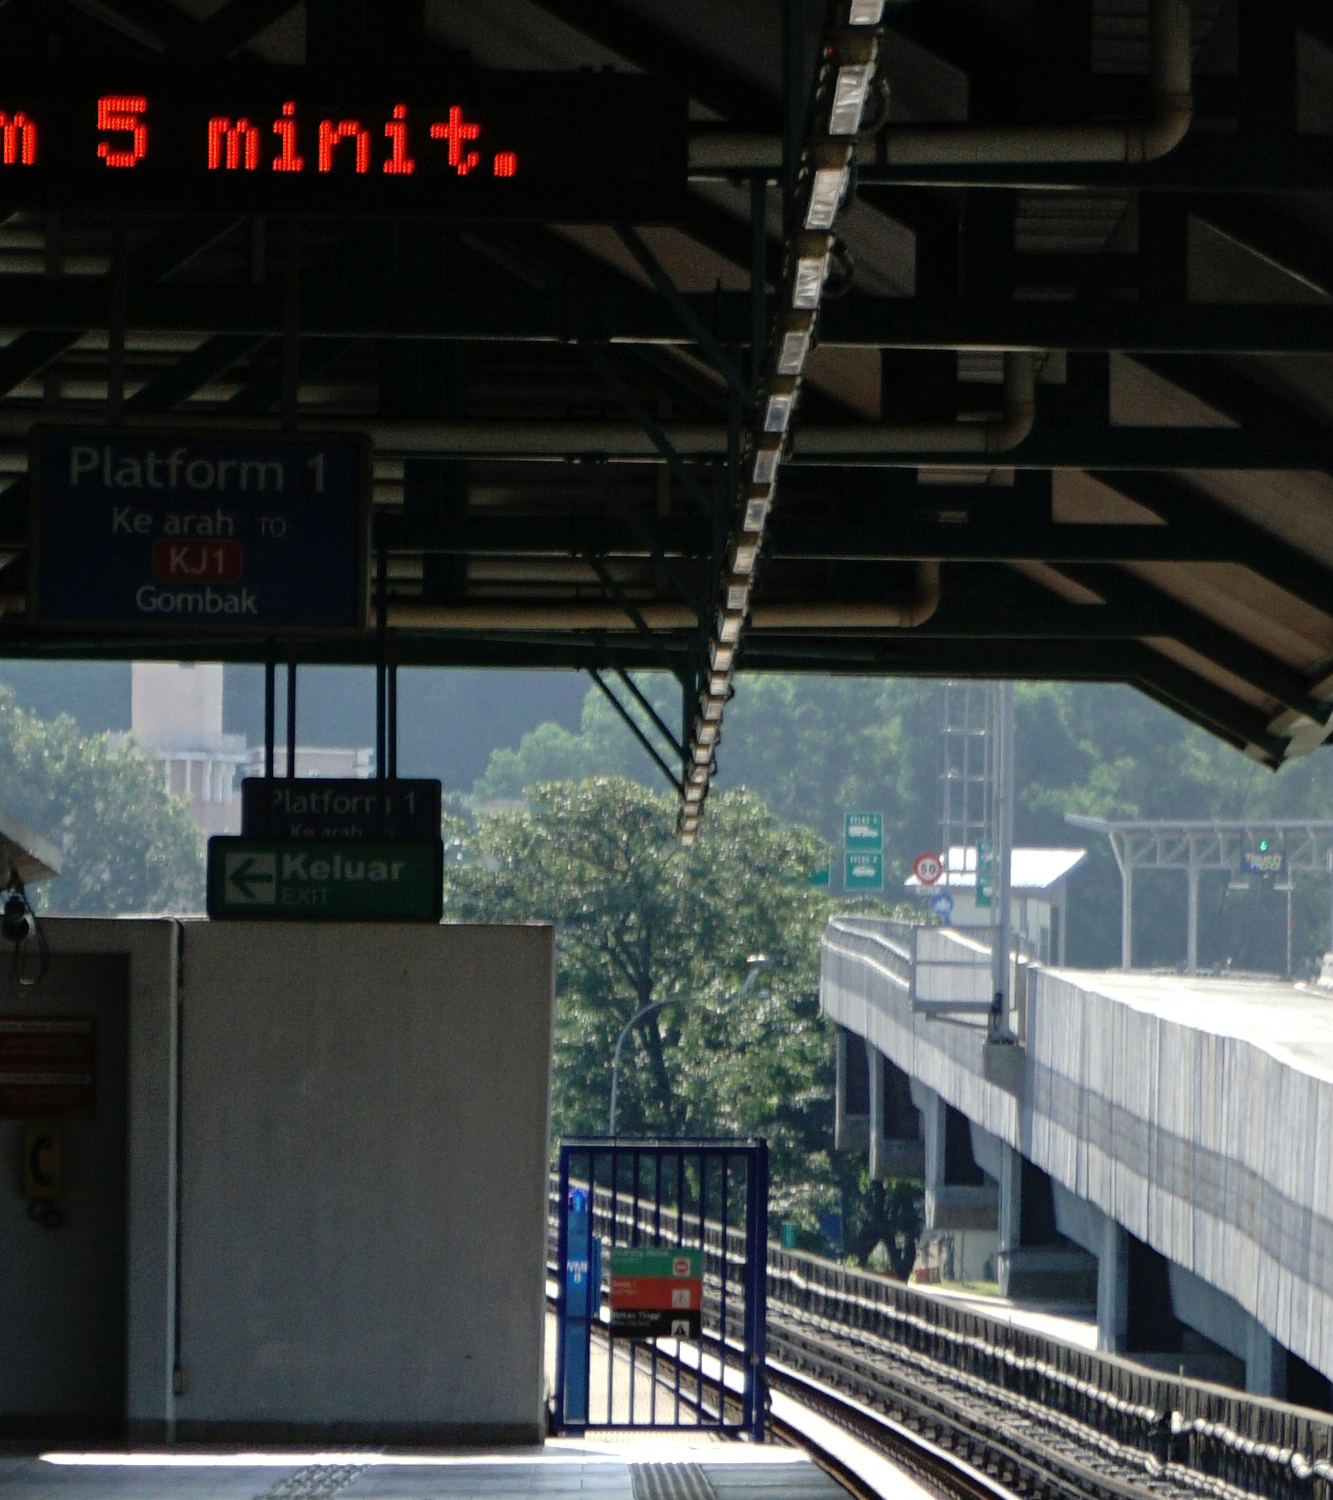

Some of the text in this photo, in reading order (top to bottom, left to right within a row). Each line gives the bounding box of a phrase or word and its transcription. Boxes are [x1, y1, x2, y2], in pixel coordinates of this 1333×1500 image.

[97, 95, 147, 168] 5
[208, 100, 518, 177] minit.
[68, 445, 326, 493] Platform 1
[111, 506, 287, 538] Ke arah TO
[168, 546, 226, 576] KJ1
[134, 584, 259, 616] Gombak
[405, 790, 417, 816] 1
[281, 853, 405, 882] Keluar
